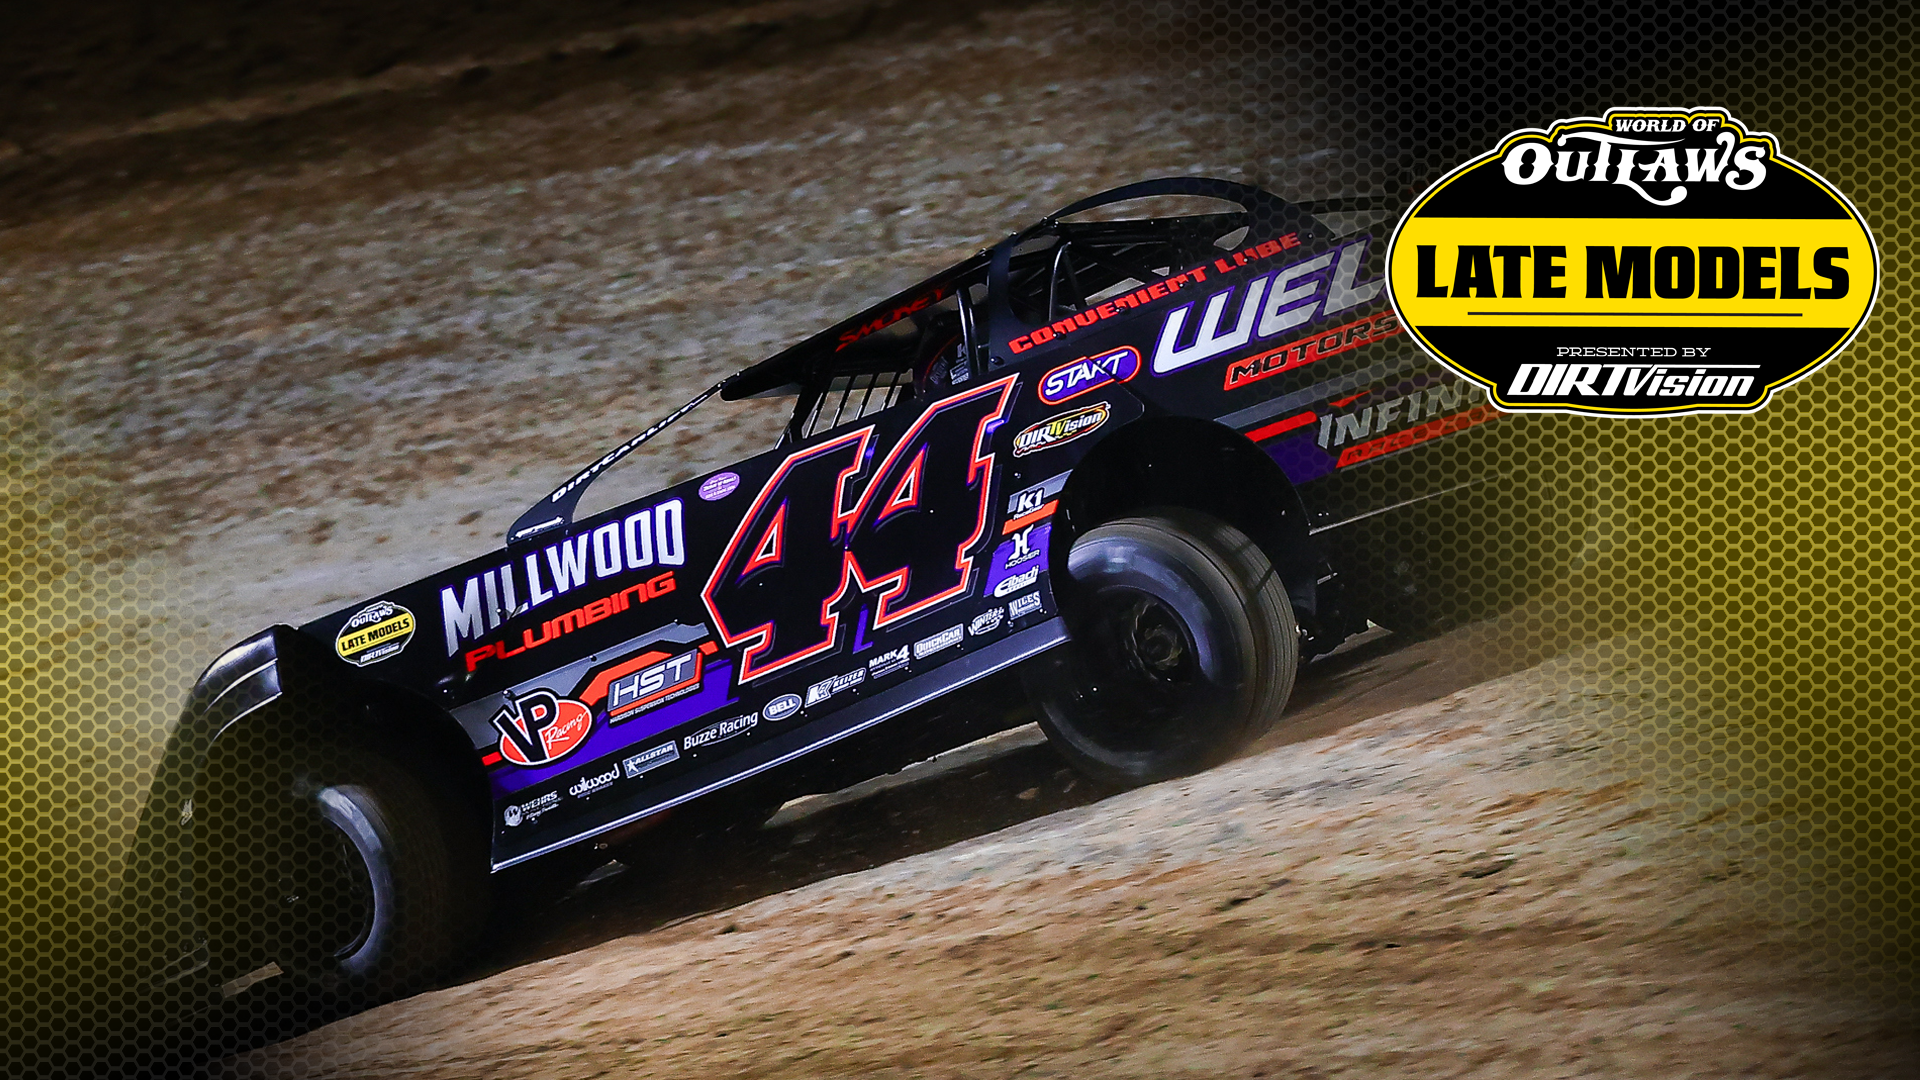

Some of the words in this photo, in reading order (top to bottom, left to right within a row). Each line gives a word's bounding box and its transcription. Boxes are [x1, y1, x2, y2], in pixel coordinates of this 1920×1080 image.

[1230, 314, 1403, 384] MOTORS
[1018, 405, 1104, 449] DIRTVision
[1016, 488, 1044, 514] K1
[700, 372, 1020, 685] 44
[441, 499, 685, 657] MILLWOOD
[341, 634, 367, 652] LATE
[367, 617, 410, 642] MODELS
[464, 570, 677, 672] PLUMBING
[612, 653, 692, 706] HST
[492, 690, 561, 766] VP
[768, 698, 797, 715] BELL
[544, 710, 588, 751] Racing
[683, 728, 718, 751] Buzze
[719, 711, 759, 737] Racing
[634, 744, 674, 765] ALLSTAR
